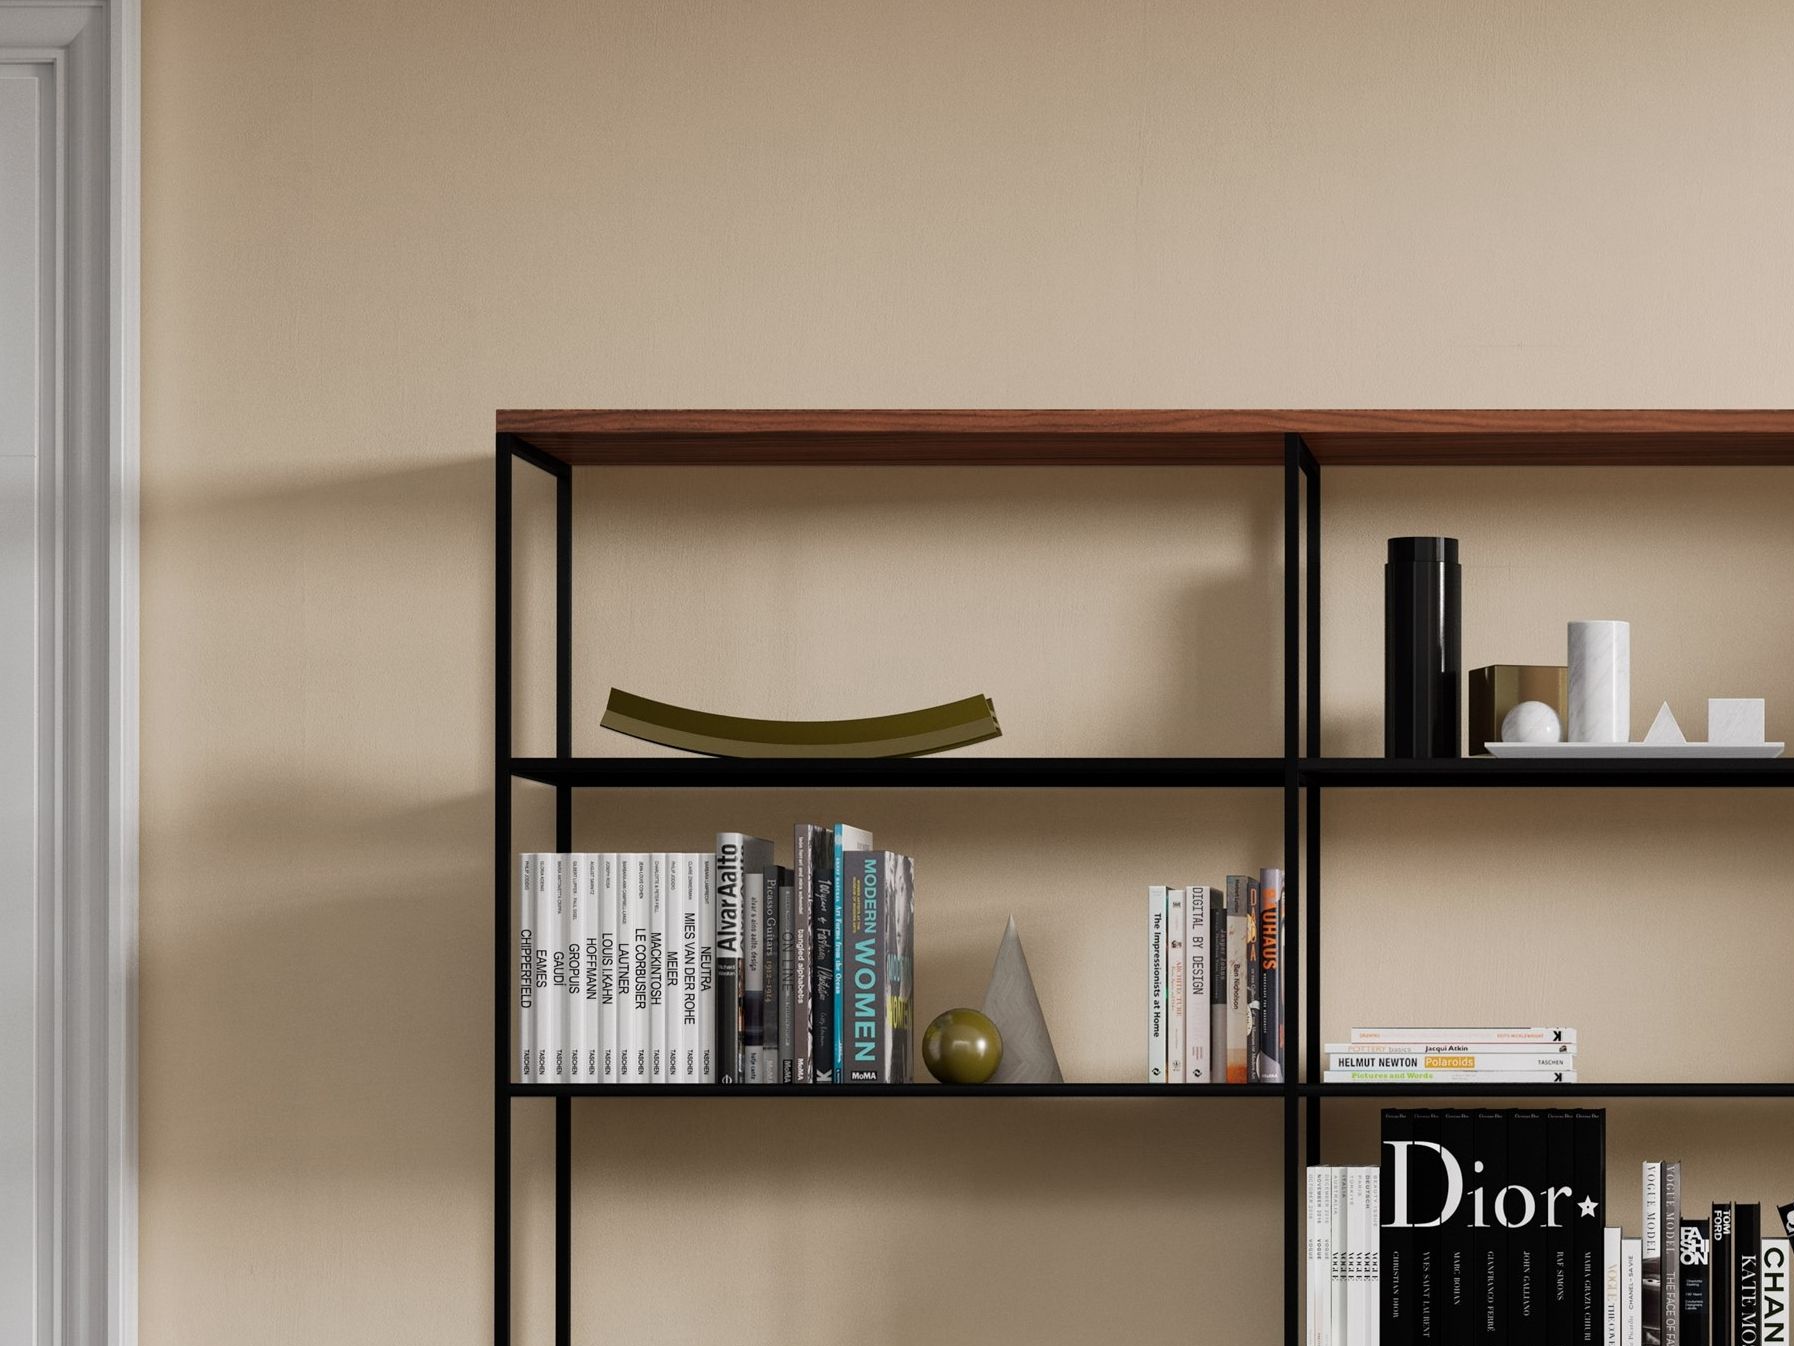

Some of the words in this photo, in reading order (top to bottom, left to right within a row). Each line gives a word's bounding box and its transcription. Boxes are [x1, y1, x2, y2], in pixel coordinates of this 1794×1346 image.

[765, 879, 776, 916] Picasso
[864, 859, 876, 933] MODERN
[1192, 887, 1204, 930] DIGITAL
[635, 928, 646, 942] LE
[684, 912, 695, 940] MIES
[765, 917, 776, 956] Guitars
[1152, 913, 1161, 929] The
[602, 933, 613, 966] LOUIS
[684, 942, 695, 964] VAN
[782, 932, 793, 956] ON
[796, 929, 804, 961] tangled
[1192, 936, 1204, 949] BY
[521, 929, 532, 1008] CHIPPERFIELD
[536, 949, 547, 988] EAMES
[569, 943, 580, 994] GROPUIS
[586, 938, 597, 1000] HOFFMANN
[618, 943, 629, 994] LAUTNER
[635, 944, 646, 1009] CORBUSIER
[650, 932, 661, 1005] MACKINTOSH
[667, 951, 678, 986] MEIER
[684, 967, 695, 991] DER
[700, 946, 711, 991] NEUTRA
[782, 959, 793, 992] LINE
[1152, 932, 1161, 998] Impressionists
[1192, 956, 1204, 995] DESIGN
[1232, 964, 1240, 977] Ben
[796, 963, 804, 1004] alphabets
[855, 938, 876, 1061] WOMEN
[1232, 979, 1240, 1010] Nicholson
[684, 993, 695, 1025] ROHE
[1152, 1000, 1161, 1010] at
[1152, 1012, 1161, 1037] Home
[1338, 1057, 1376, 1068] HELMUT
[1378, 1057, 1418, 1068] NEWTON
[1425, 1057, 1474, 1068] Polaroids
[1425, 1045, 1447, 1053] Jacqui
[783, 1060, 792, 1083] MoMA
[851, 1072, 876, 1080] MoMA
[1381, 1140, 1573, 1229] Dior
[1666, 1166, 1675, 1207] VOGUE
[1666, 1212, 1675, 1255] MODEL
[1714, 1210, 1722, 1241] FORD
[1556, 1251, 1564, 1268] RAF
[1556, 1269, 1564, 1301] SIMONS
[1666, 1272, 1675, 1290] THE
[1741, 1255, 1756, 1308] KATE
[1666, 1292, 1675, 1316] FACE
[1666, 1319, 1675, 1331] OF
